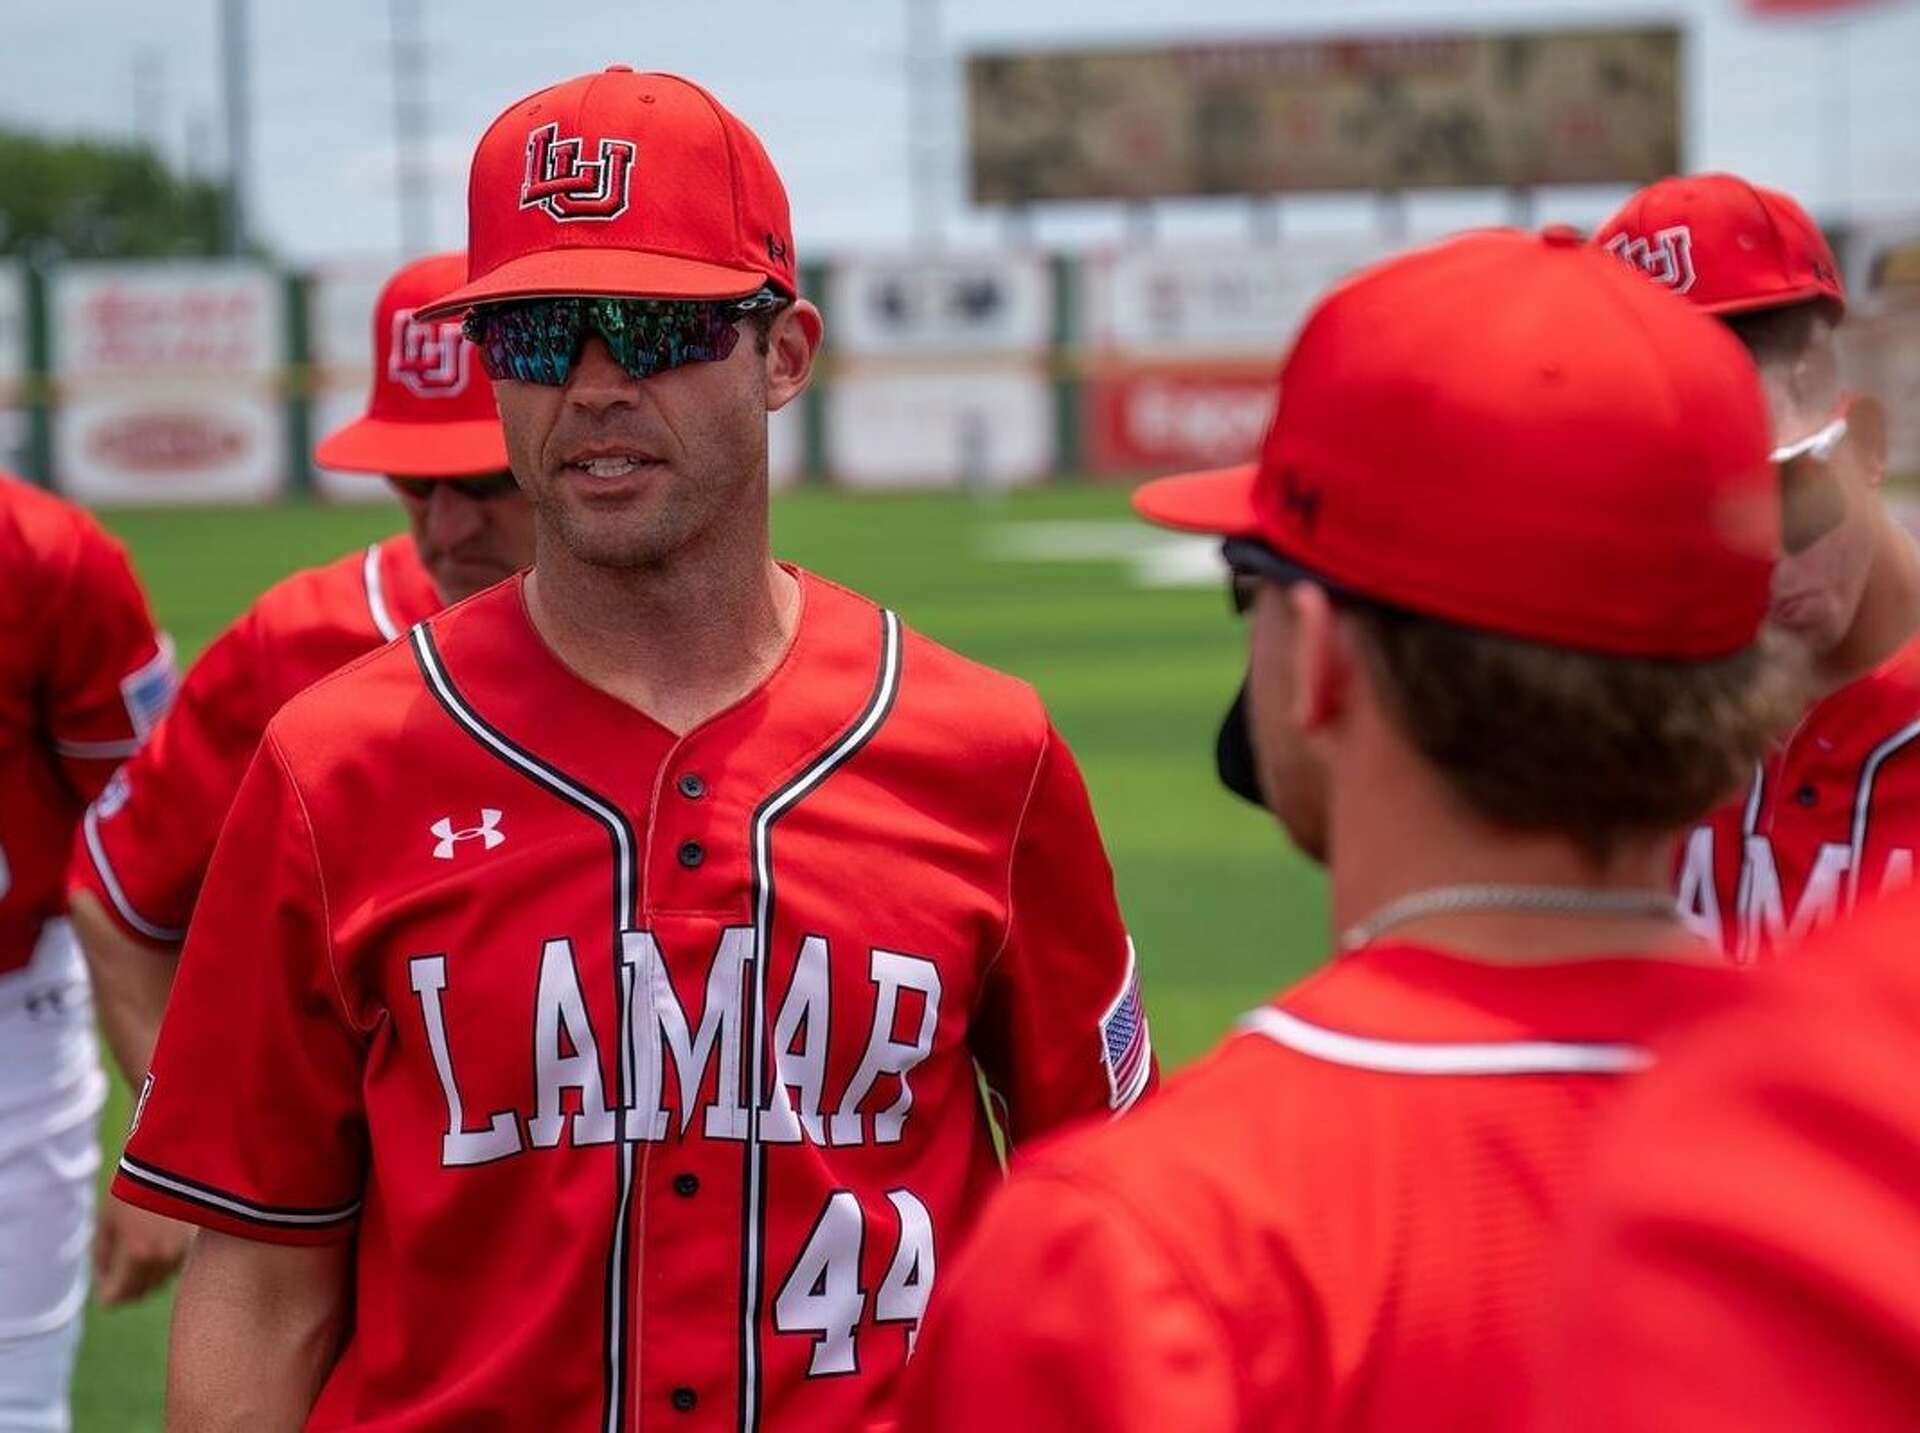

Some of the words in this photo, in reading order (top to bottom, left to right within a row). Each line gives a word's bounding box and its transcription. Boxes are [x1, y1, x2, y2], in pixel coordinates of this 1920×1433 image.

[518, 121, 637, 223] LU
[388, 308, 471, 398] LU
[409, 925, 942, 1167] LAMAR
[774, 1186, 937, 1379] 44
